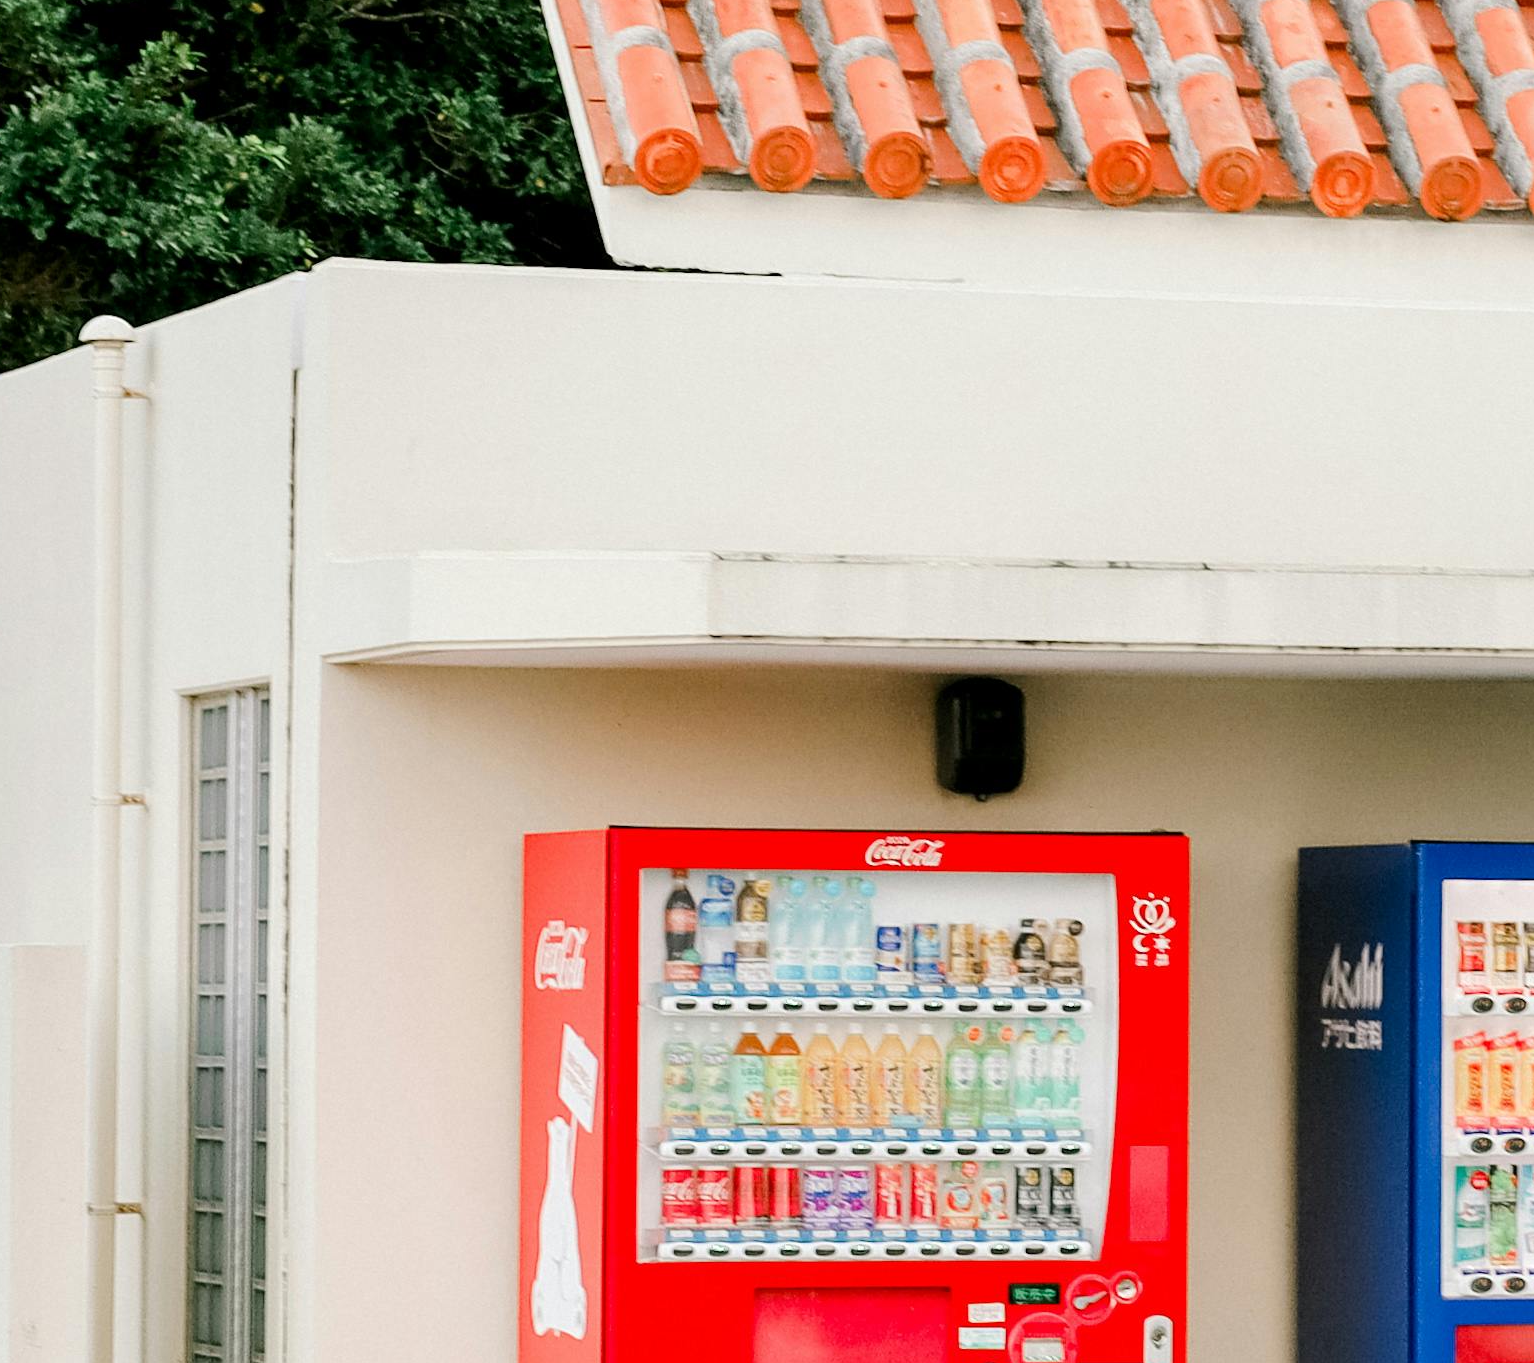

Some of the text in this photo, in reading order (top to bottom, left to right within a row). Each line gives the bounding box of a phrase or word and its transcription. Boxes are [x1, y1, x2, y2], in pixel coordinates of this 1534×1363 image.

[1321, 942, 1384, 1009] Asahi
[1320, 1019, 1383, 1051] アサヒ飲料
